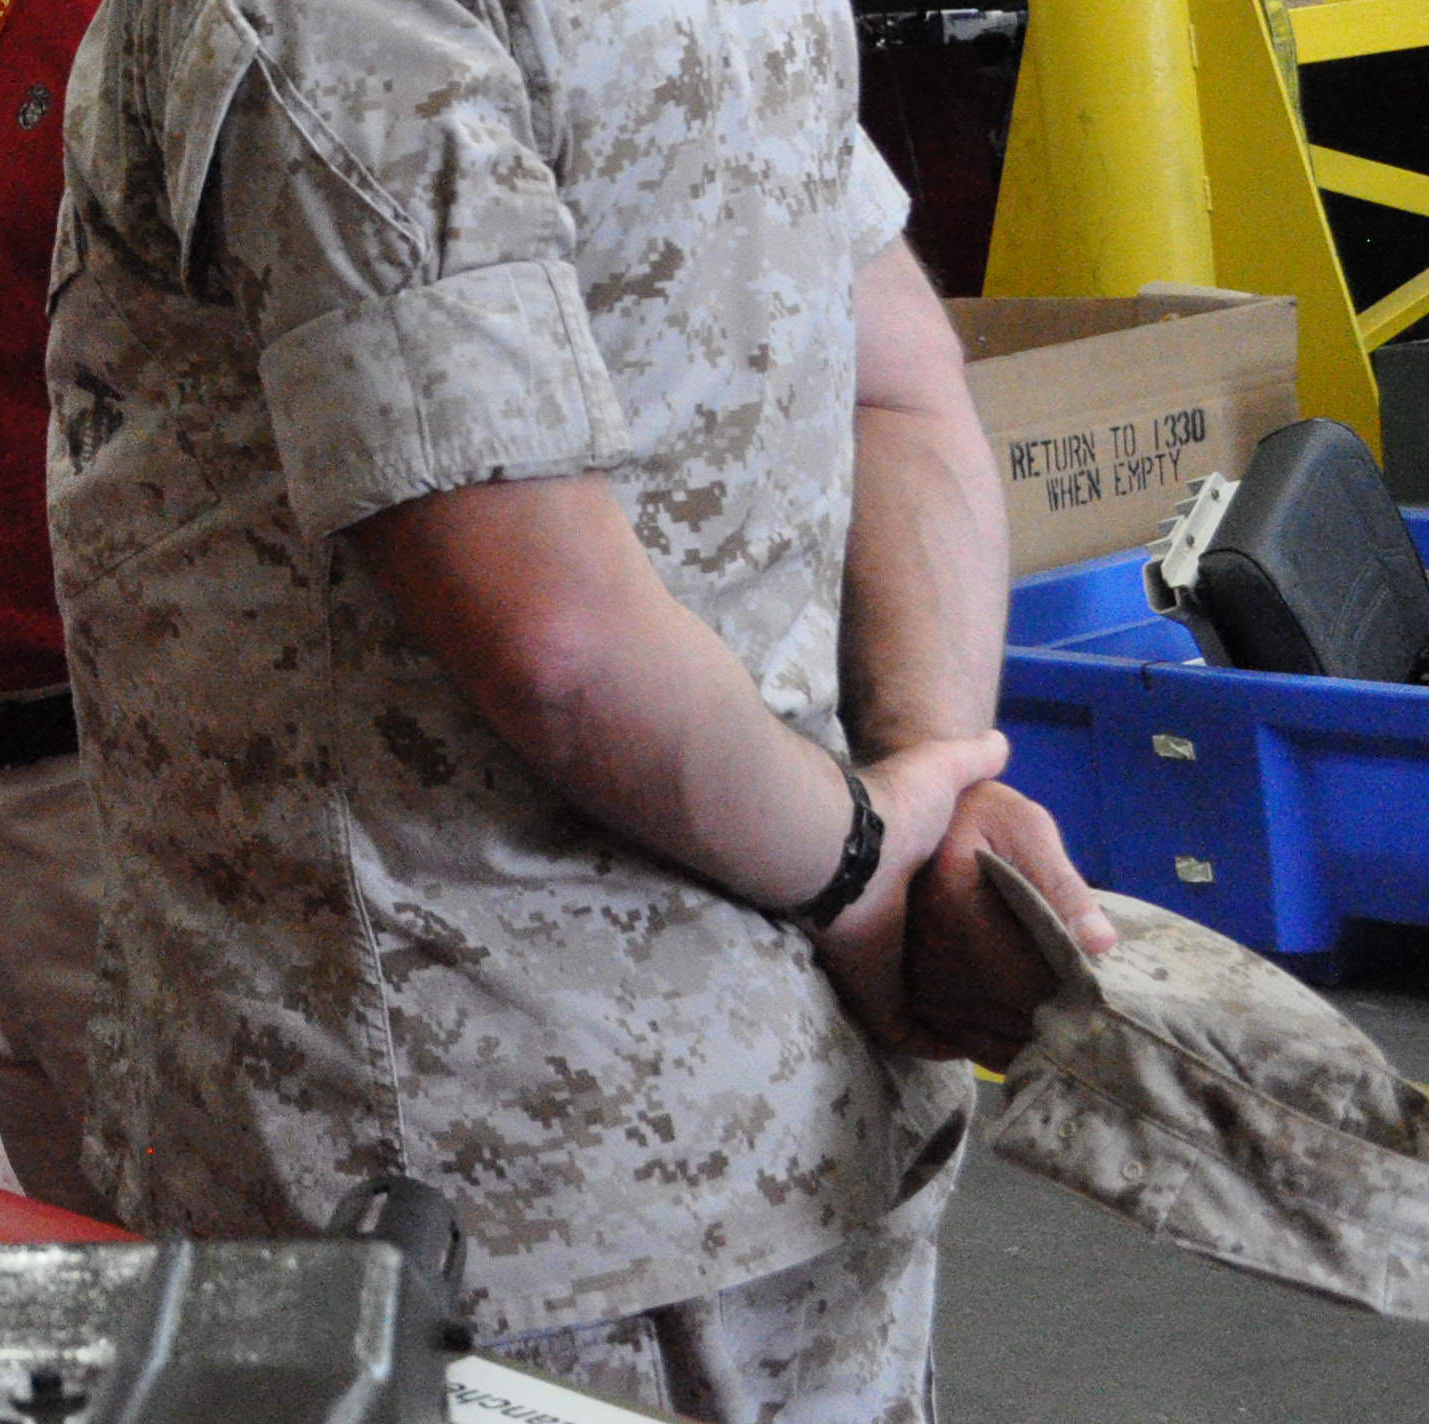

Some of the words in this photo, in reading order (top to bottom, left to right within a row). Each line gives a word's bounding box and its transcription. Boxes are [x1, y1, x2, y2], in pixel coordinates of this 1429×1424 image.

[1009, 431, 1096, 481] RETURN
[1110, 422, 1137, 459] TO
[1153, 407, 1207, 452] 1330
[1046, 466, 1102, 512] WHEN
[1113, 448, 1182, 497] EMPTY
